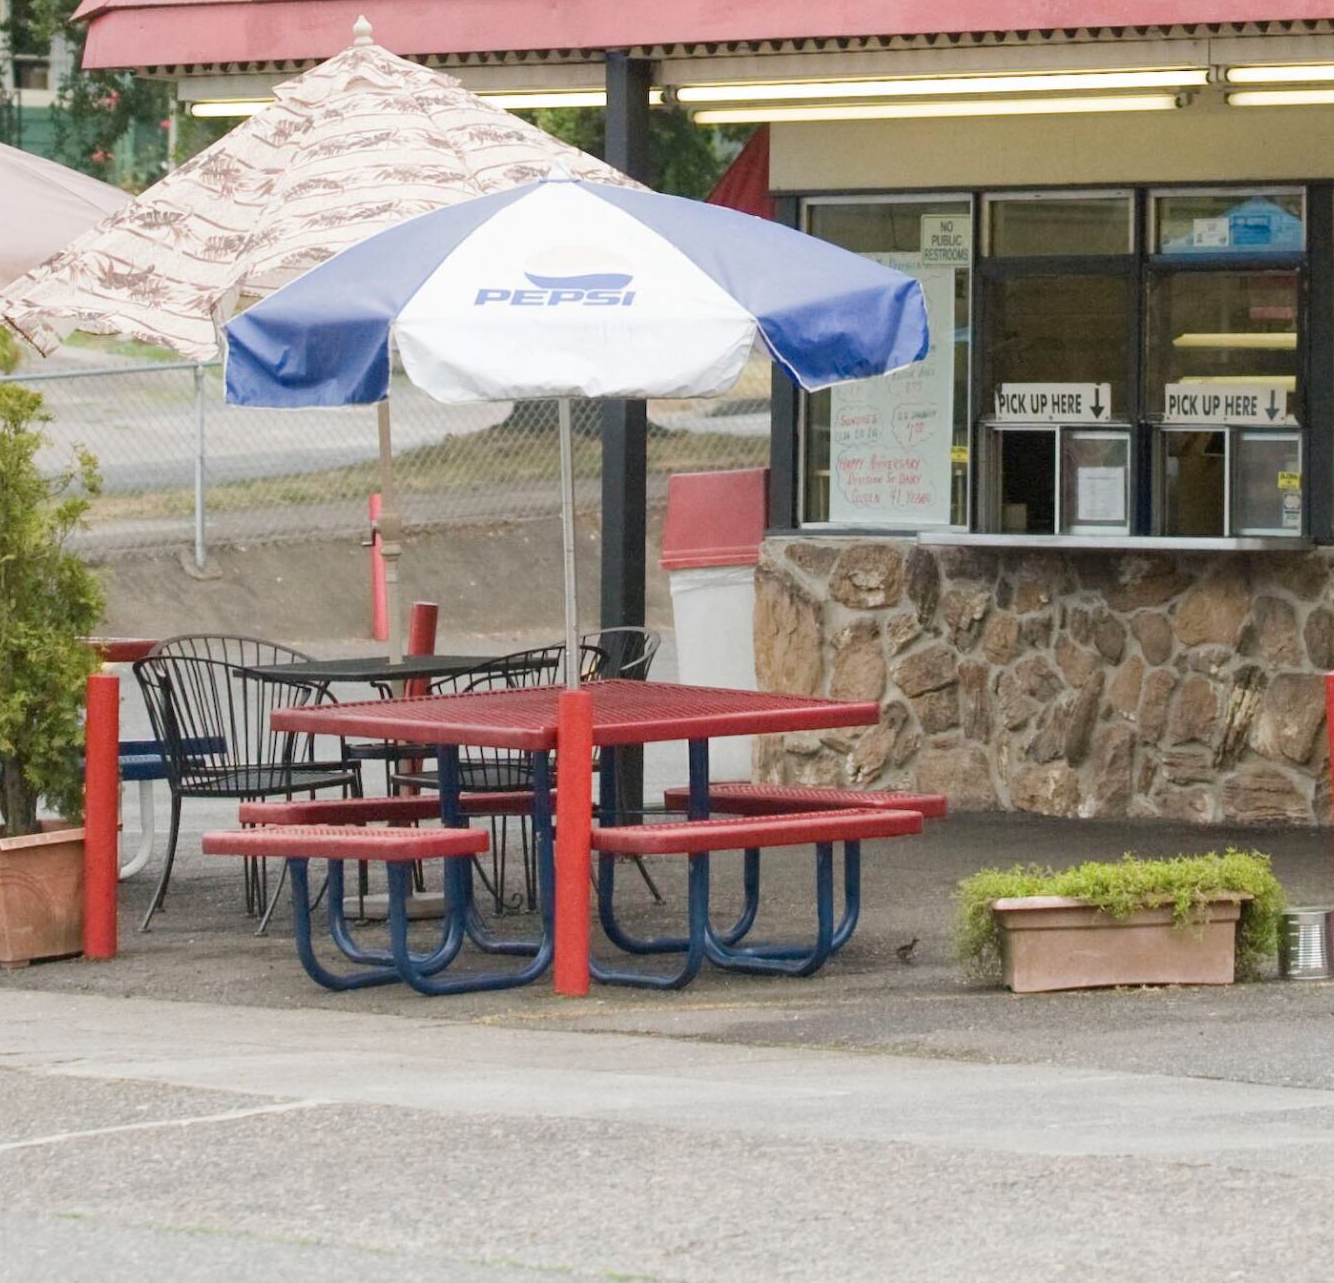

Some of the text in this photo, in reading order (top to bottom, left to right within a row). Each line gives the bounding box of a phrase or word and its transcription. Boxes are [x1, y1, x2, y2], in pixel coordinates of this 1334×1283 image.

[940, 221, 954, 232] NO
[931, 235, 963, 246] PUBLIC
[924, 248, 969, 261] RESTROOMS
[473, 289, 636, 307] PEPSI
[999, 393, 1082, 415] PICK UP HERE
[1168, 395, 1258, 416] PICK UP HERE
